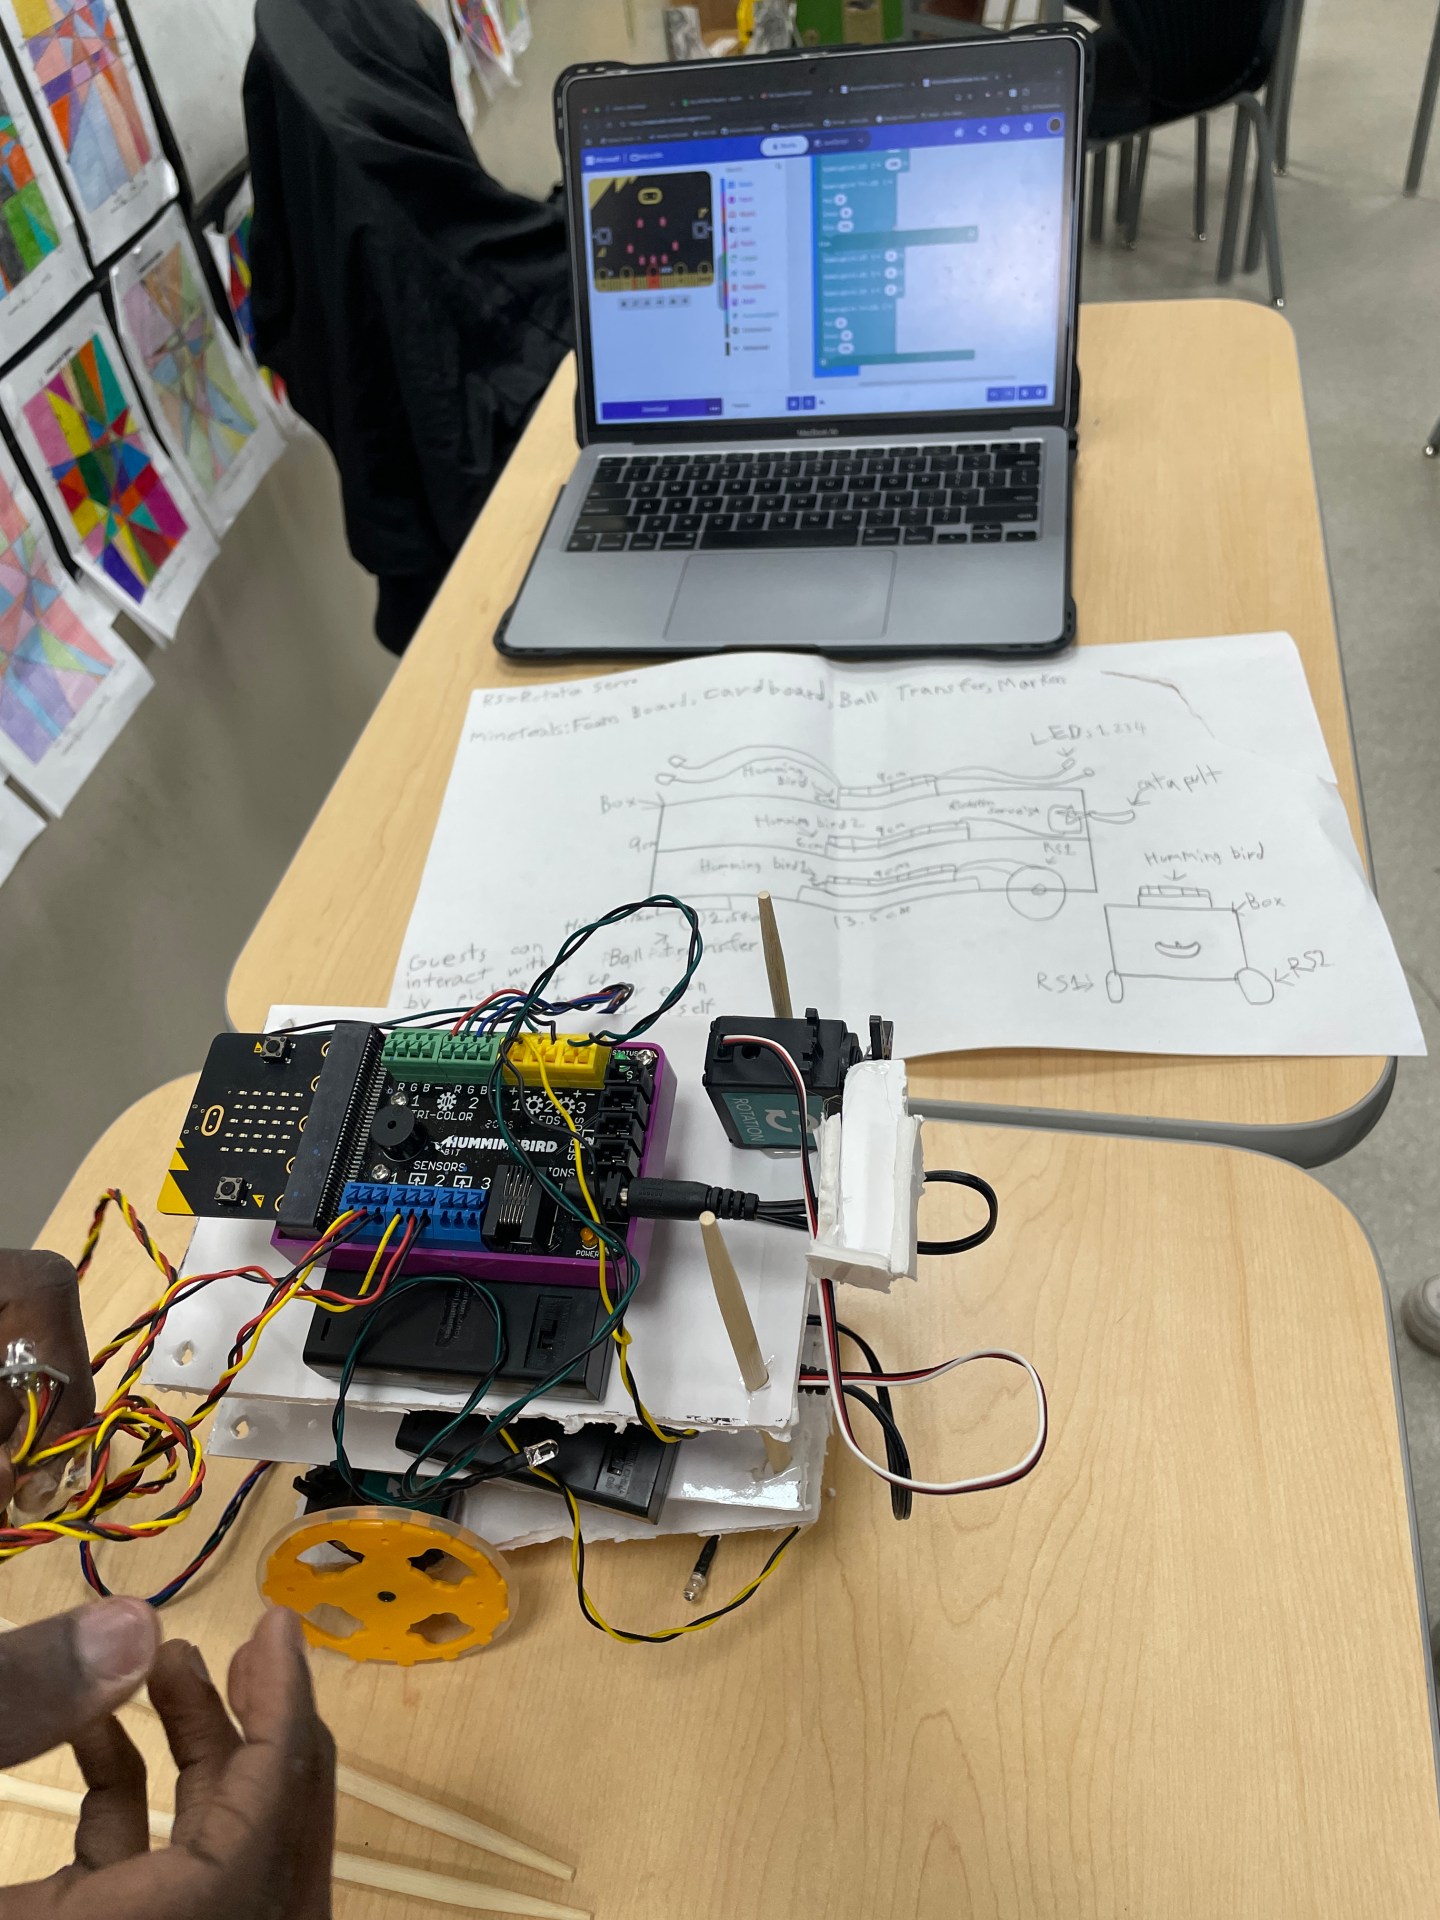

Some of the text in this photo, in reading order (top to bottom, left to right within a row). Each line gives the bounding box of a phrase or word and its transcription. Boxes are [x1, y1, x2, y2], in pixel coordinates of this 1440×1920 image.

[839, 689, 880, 710] Ball
[600, 795, 637, 814] Box
[1144, 841, 1265, 867] Humming bird
[1245, 891, 1286, 911] Box
[408, 942, 544, 972] Guests can
[608, 932, 760, 968] Ball trnsfer
[405, 955, 548, 990] interact with
[397, 1082, 489, 1095] R G B R G B
[411, 1094, 587, 1114] 1 2 1 2 3
[729, 1097, 767, 1143] ROTATION
[443, 1148, 461, 1157] BIT
[446, 1136, 559, 1153] HUMMINBIRD
[413, 1160, 466, 1172] SENSORS
[389, 1172, 492, 1190] 1 2 3
[575, 1249, 599, 1258] POWER
